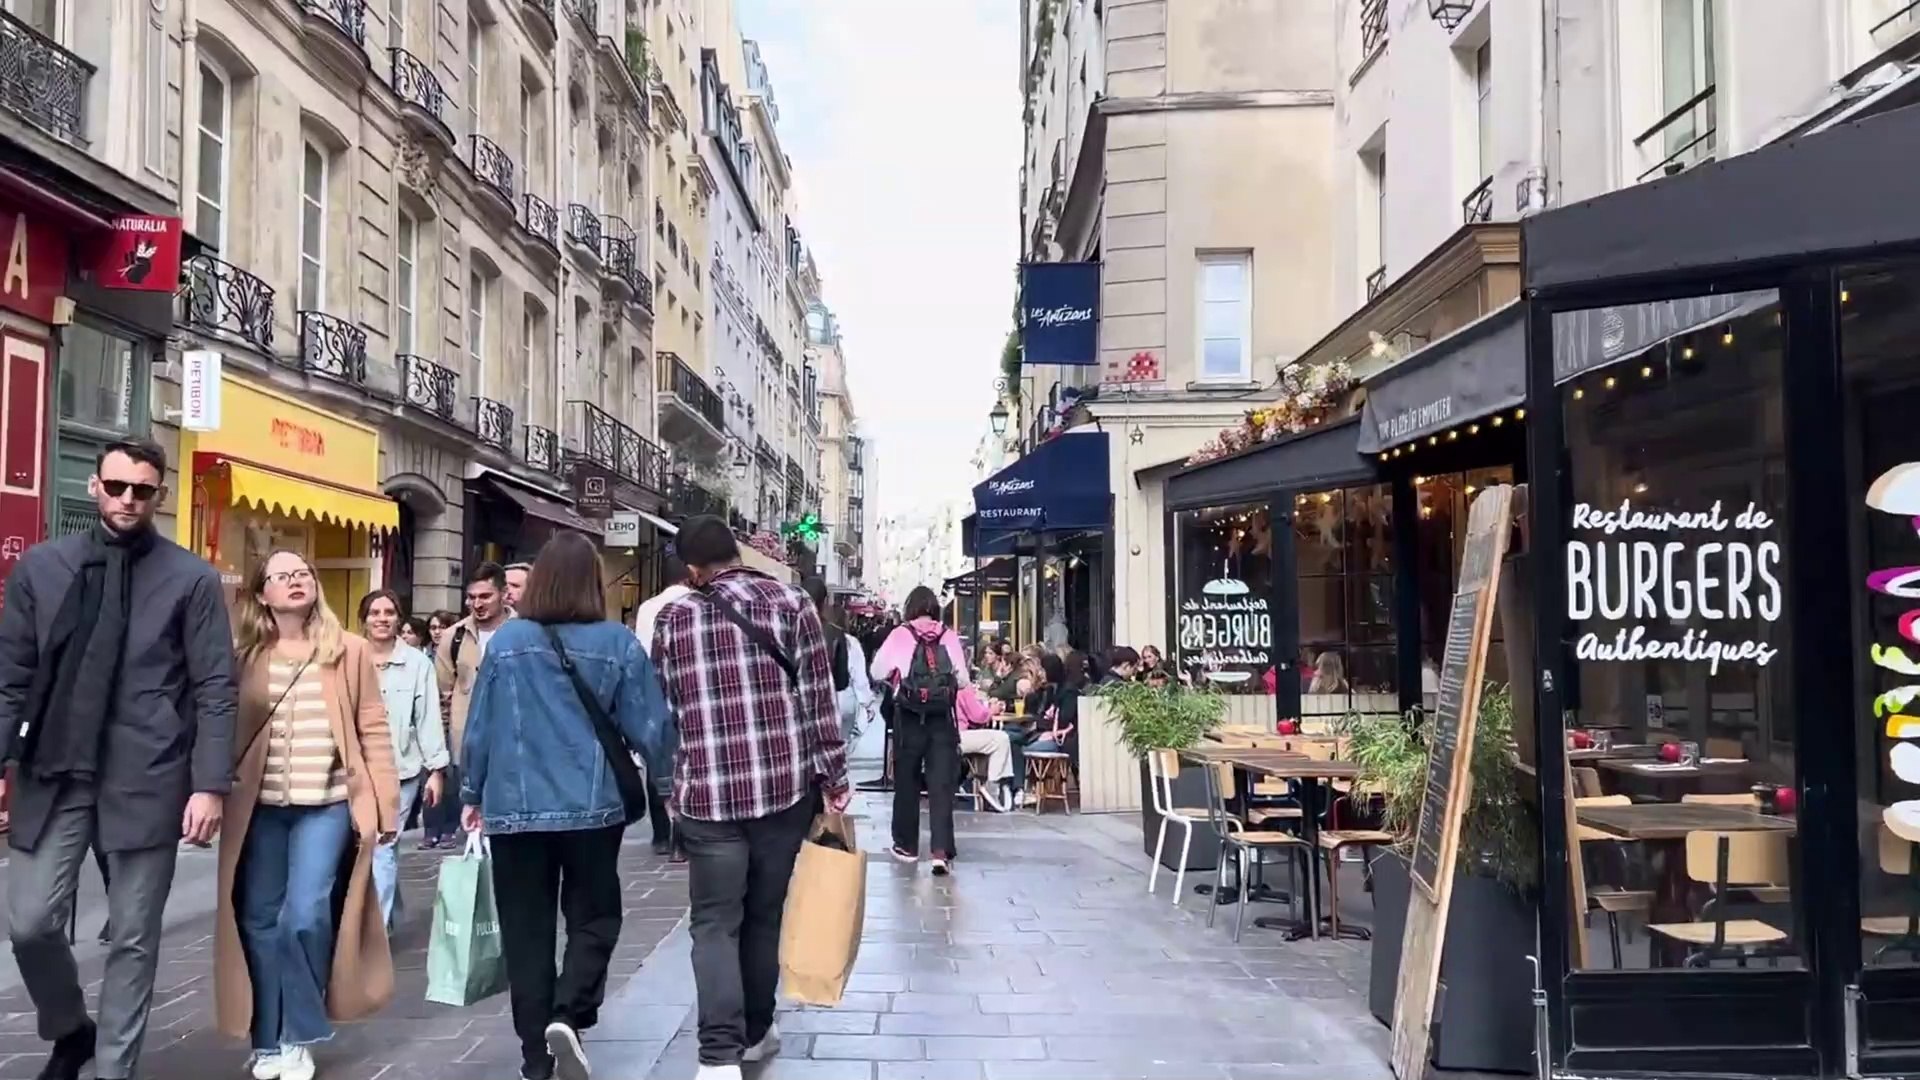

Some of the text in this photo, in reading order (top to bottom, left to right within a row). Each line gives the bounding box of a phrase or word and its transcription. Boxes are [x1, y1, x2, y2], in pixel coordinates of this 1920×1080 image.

[111, 218, 168, 233] NATURALIA
[190, 360, 202, 419] PETIBON
[607, 522, 636, 531] LEHO
[980, 507, 1042, 518] RESTAURANT
[1573, 498, 1774, 534] Restaurant de
[1567, 541, 1782, 621] BURGERS
[1576, 625, 1778, 676] Authentiques
